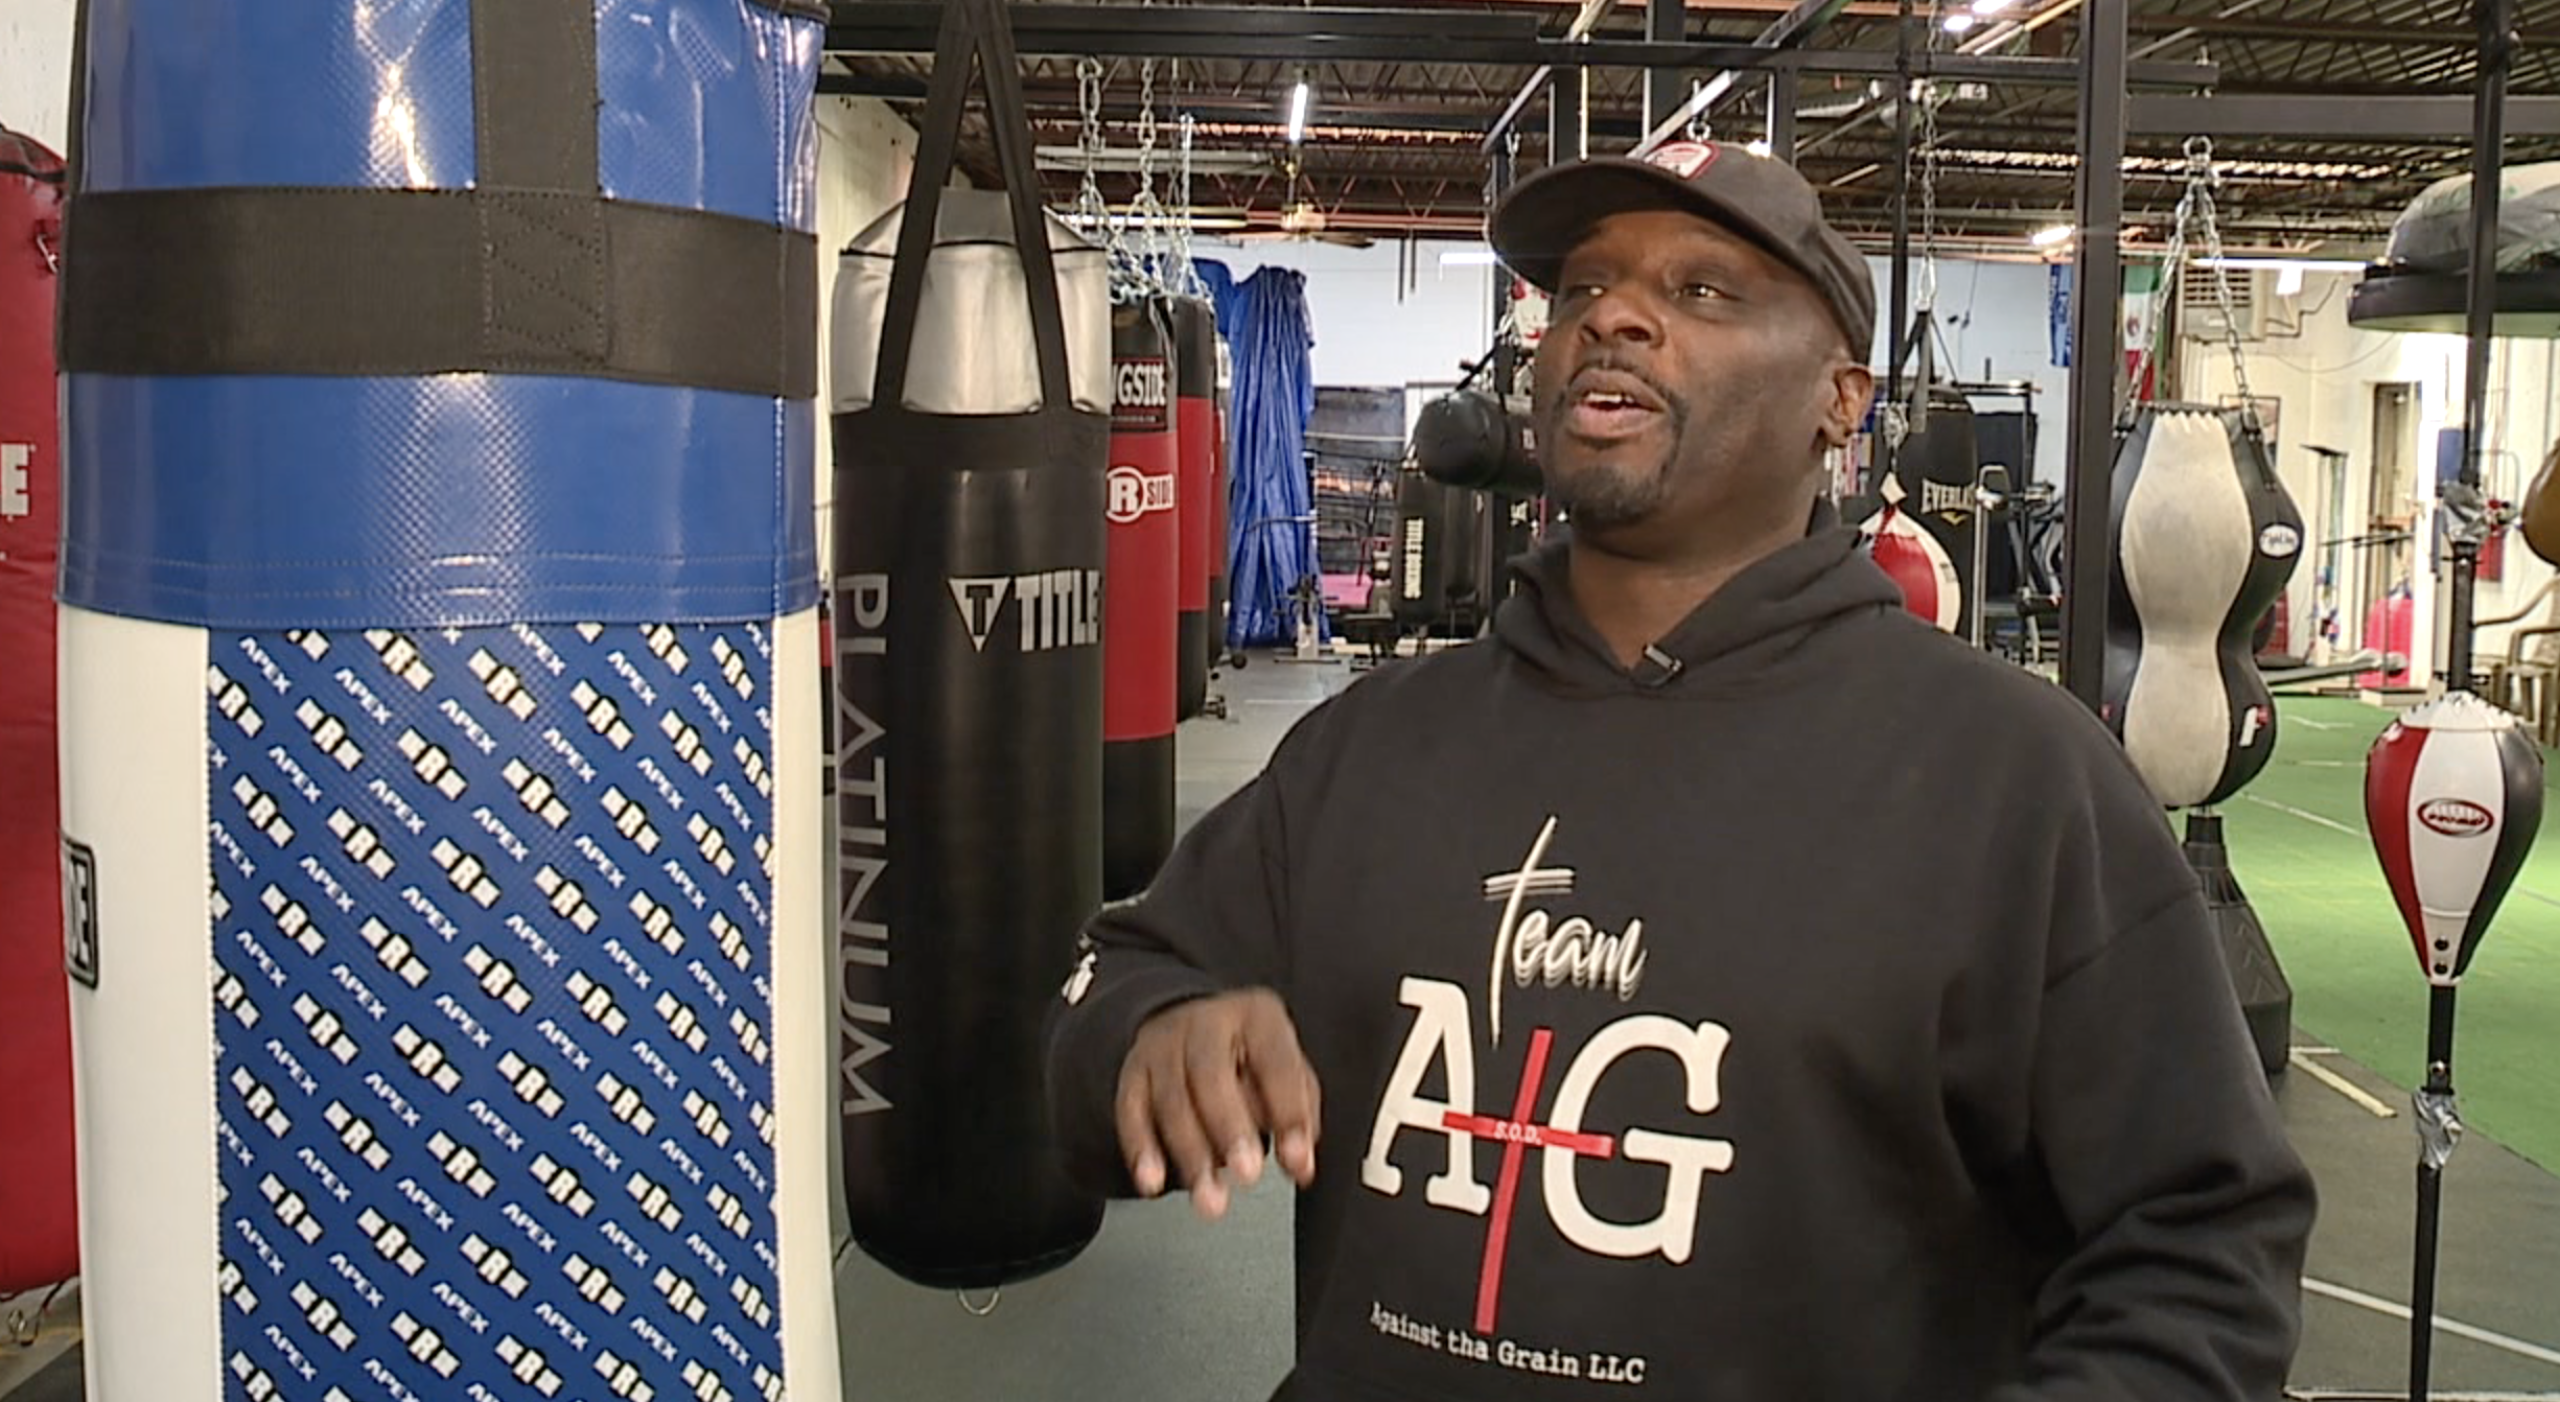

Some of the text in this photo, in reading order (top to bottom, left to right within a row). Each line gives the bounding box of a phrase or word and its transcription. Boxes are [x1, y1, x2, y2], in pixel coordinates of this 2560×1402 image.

[1015, 569, 1100, 652] TITLE
[240, 637, 291, 693] APEX
[607, 651, 657, 705] APEX
[335, 668, 392, 724] APEX
[439, 699, 496, 753] APEX
[269, 746, 322, 801] APEX
[543, 727, 596, 782] APEX
[370, 779, 426, 833] APEX
[637, 757, 684, 809] APEX
[472, 806, 529, 861] APEX
[836, 572, 894, 1116] PLATINUM
[300, 856, 356, 912] APEX
[574, 835, 626, 887] APEX
[663, 860, 706, 909] APEX
[402, 886, 459, 941] APEX
[505, 914, 560, 967] APEX
[1485, 815, 1647, 1050] Team
[236, 930, 287, 987] APEX
[603, 938, 652, 989] APEX
[332, 964, 387, 1020] APEX
[435, 994, 492, 1047] APEX
[536, 1019, 591, 1070] APEX
[266, 1039, 318, 1094] APEX
[632, 1040, 679, 1089] APEX
[365, 1073, 421, 1127] APEX
[467, 1099, 525, 1151] APEX
[219, 1121, 254, 1166] PEX
[570, 1122, 622, 1171] APEX
[660, 1139, 703, 1184] APEX
[298, 1148, 351, 1202] APEX
[397, 1178, 454, 1231] APEX
[502, 1203, 557, 1252] APEX
[236, 1218, 284, 1275] APEX
[600, 1220, 650, 1267] APEX
[329, 1253, 384, 1307] APEX
[432, 1282, 490, 1333] APEX
[535, 1303, 588, 1349] APEX
[265, 1326, 317, 1380] APEX
[630, 1316, 678, 1360] APEX
[1369, 1301, 1646, 1384] Against tha Grain LLC
